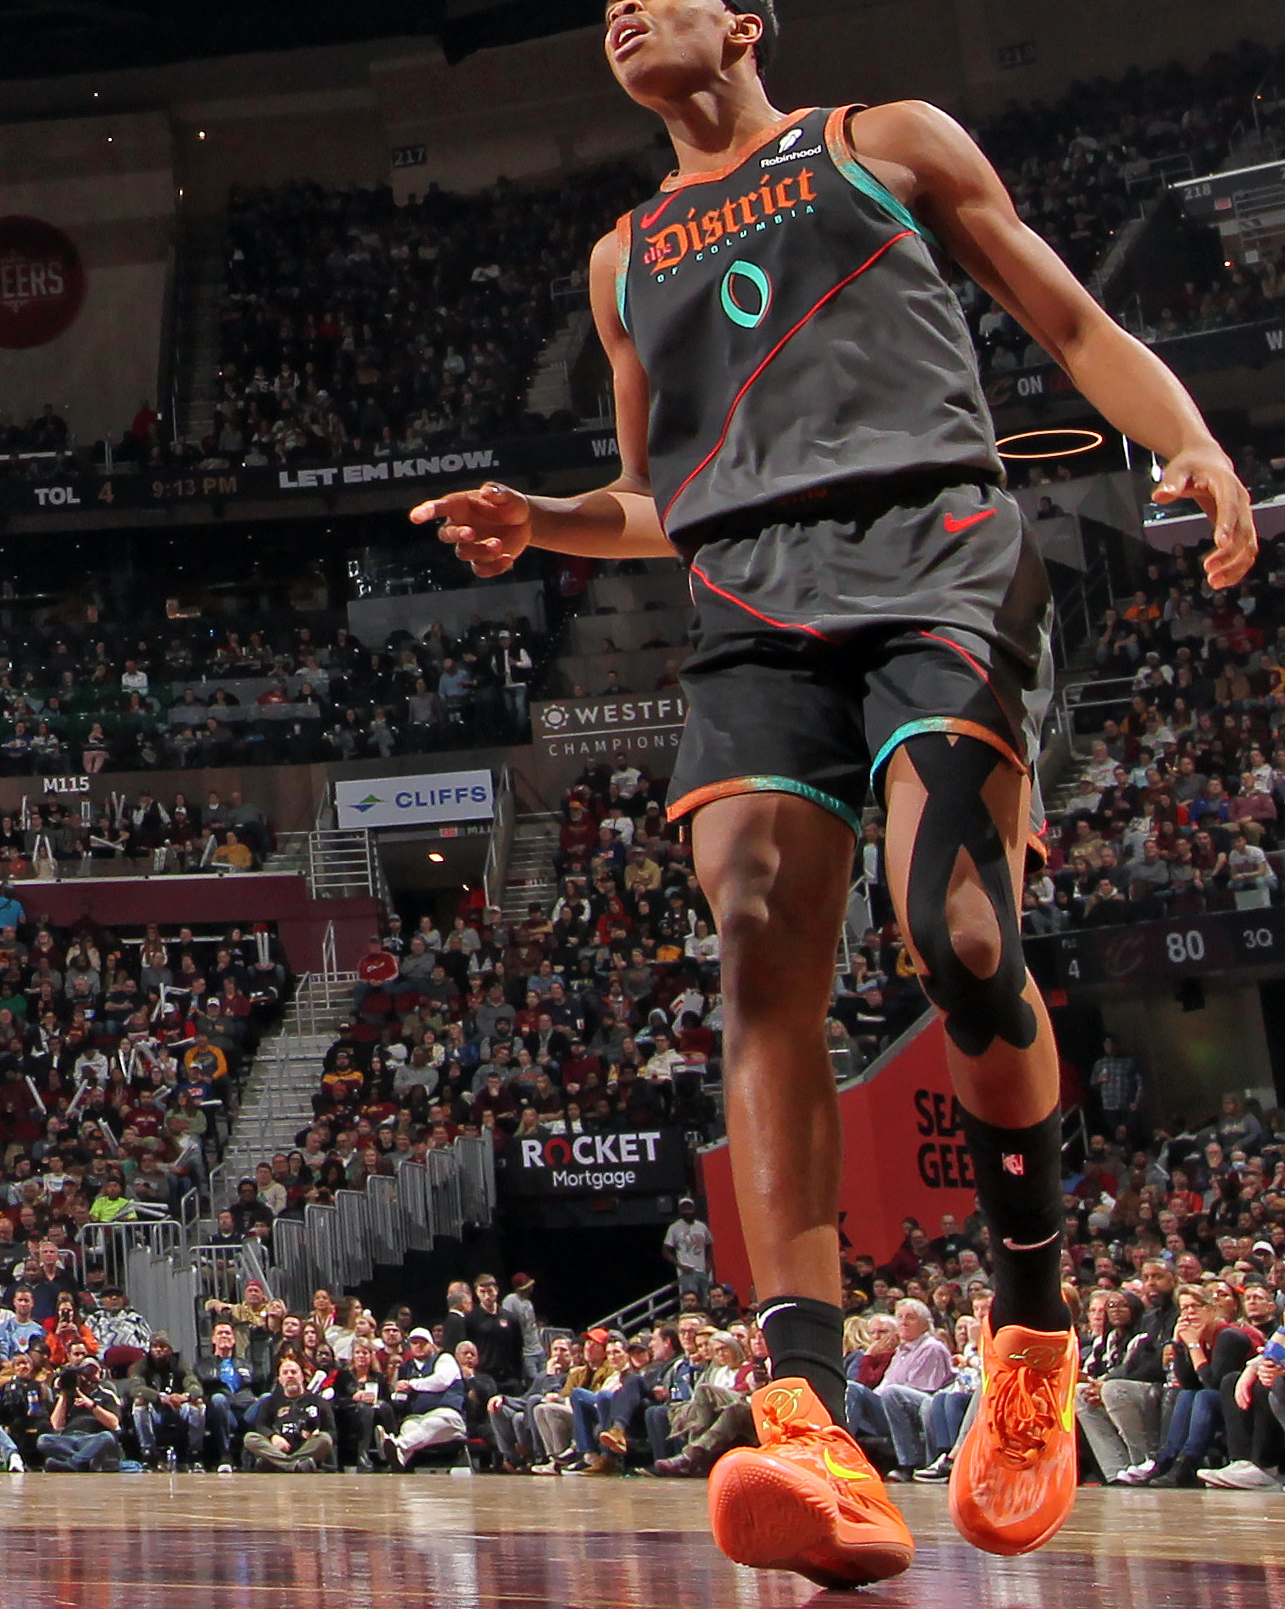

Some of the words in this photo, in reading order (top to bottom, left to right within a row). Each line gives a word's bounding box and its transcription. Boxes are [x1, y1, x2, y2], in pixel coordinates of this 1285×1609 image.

[759, 145, 822, 168] Robinhood
[645, 167, 817, 276] District
[657, 267, 678, 283] OF
[696, 205, 814, 261] COLUMBIA
[720, 260, 774, 329] 0
[1017, 375, 1043, 397] ON
[279, 468, 335, 489] LET
[343, 463, 391, 484] EM
[393, 450, 500, 479] KNOW.
[34, 486, 81, 506] TOL
[152, 478, 195, 500] 9:13
[203, 475, 237, 496] PM
[574, 699, 684, 725] WESTFI
[549, 734, 678, 756] CHAMPIONS
[43, 776, 90, 793] M115
[395, 786, 487, 808] CLIFFS
[1166, 930, 1205, 963] 80
[1243, 928, 1273, 948] 3Q
[1068, 960, 1079, 979] 4
[521, 1131, 661, 1168] ROCKET
[552, 1170, 635, 1190] Mortgage
